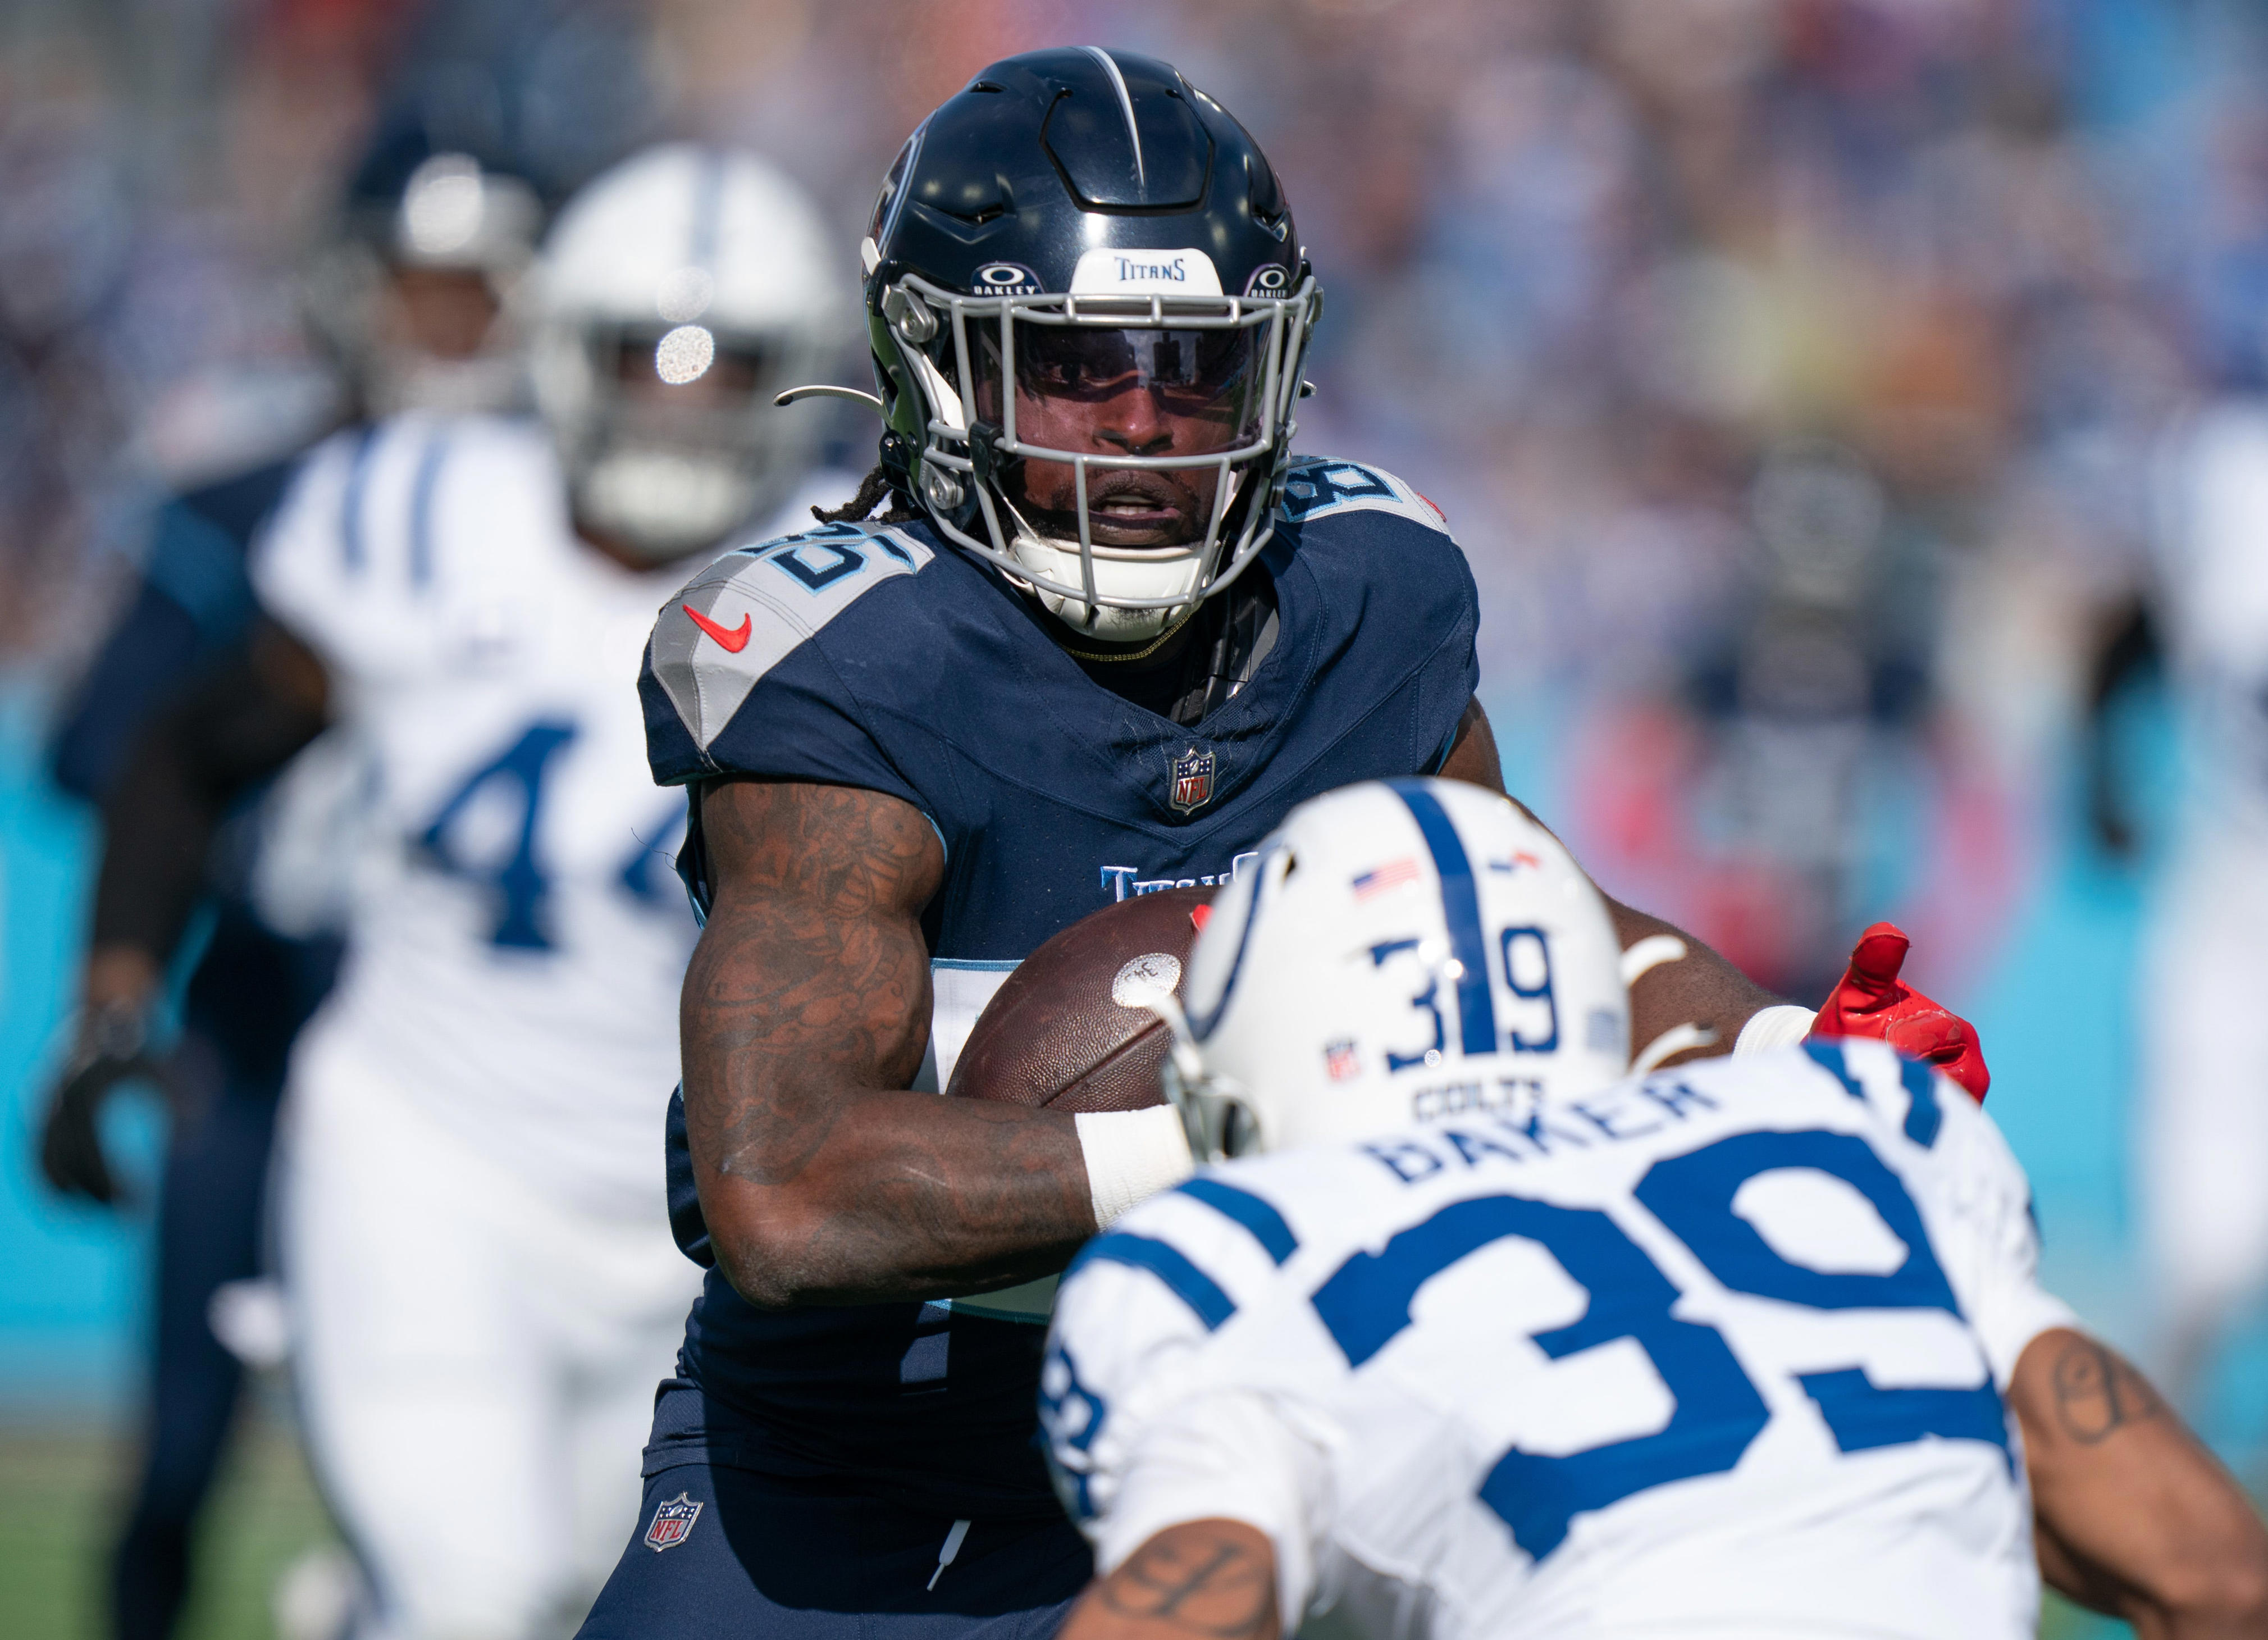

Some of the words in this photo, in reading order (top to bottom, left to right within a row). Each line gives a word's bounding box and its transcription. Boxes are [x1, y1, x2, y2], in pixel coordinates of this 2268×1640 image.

[1114, 257, 1184, 281] TITANS
[974, 285, 1036, 296] OAKLEY
[1177, 777, 1207, 803] NFL
[1369, 925, 1560, 1075] 39
[1359, 1081, 1719, 1184] BAKER
[1309, 1126, 2021, 1565] 39
[651, 1520, 683, 1542] NFL
